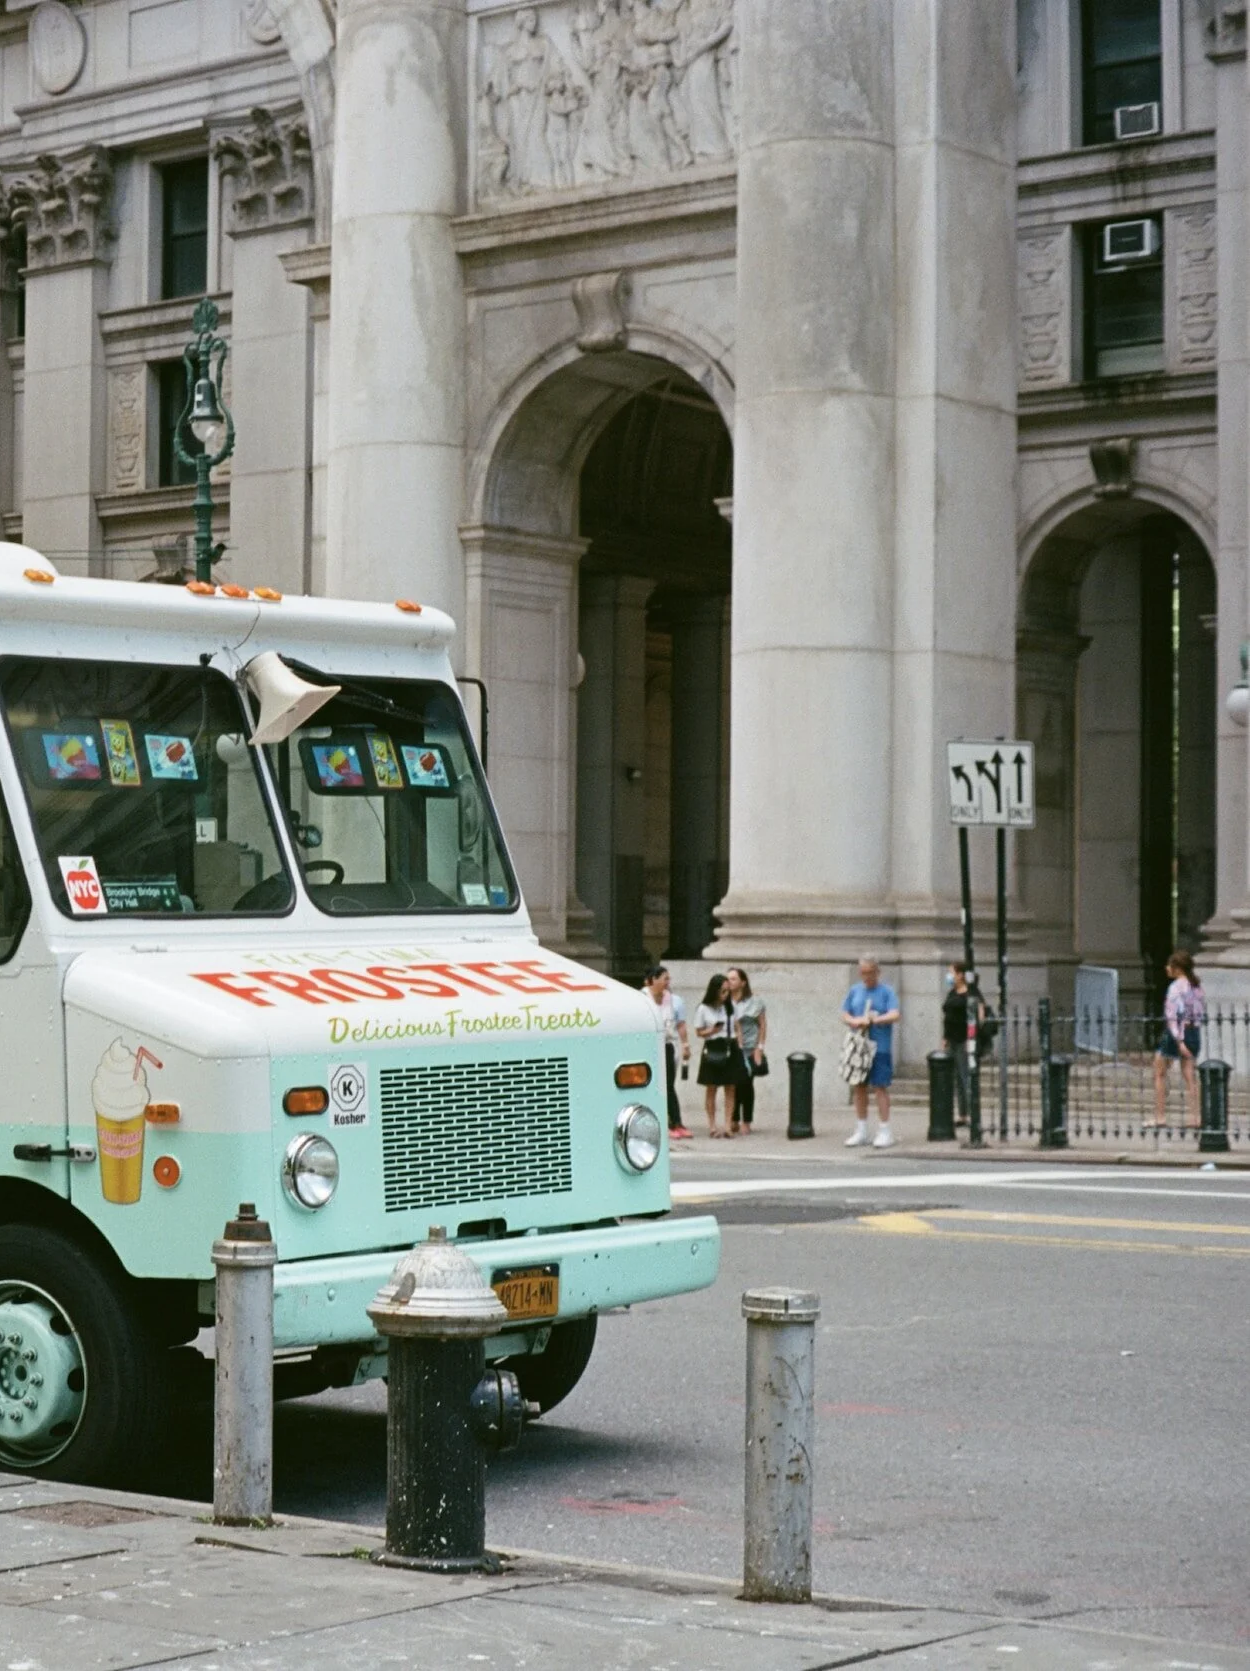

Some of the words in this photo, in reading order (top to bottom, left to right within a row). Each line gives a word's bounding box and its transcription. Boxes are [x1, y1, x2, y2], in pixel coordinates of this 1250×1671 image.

[68, 879, 99, 898] NYC
[106, 888, 136, 898] Brooklyn
[137, 887, 160, 898] Bridge
[187, 959, 608, 1007] FROSTEE
[327, 1016, 446, 1045] Delicious
[444, 1008, 521, 1039] Frostee
[518, 1004, 601, 1032] Treats
[342, 1080, 354, 1097] K
[334, 1113, 366, 1126] Kosher
